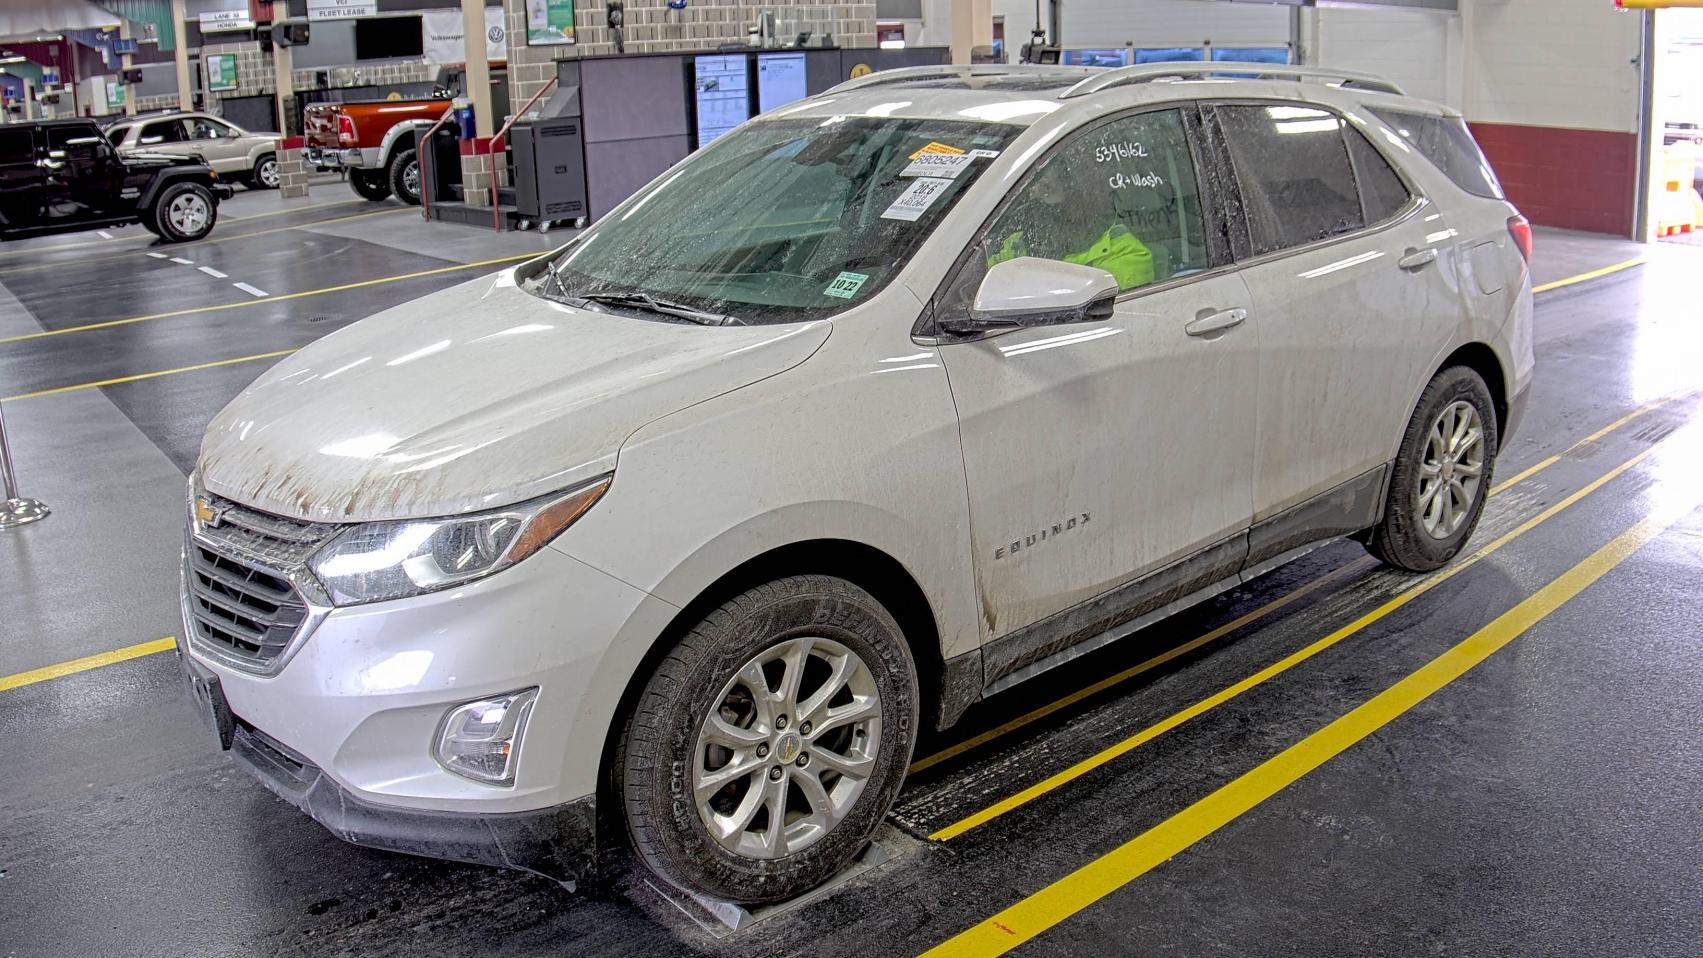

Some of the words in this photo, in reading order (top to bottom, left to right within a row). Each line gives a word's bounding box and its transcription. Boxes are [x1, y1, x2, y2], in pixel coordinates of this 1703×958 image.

[342, 8, 366, 16] LEASE
[1095, 141, 1148, 162] 5346162
[994, 512, 1091, 561] EQUINOX
